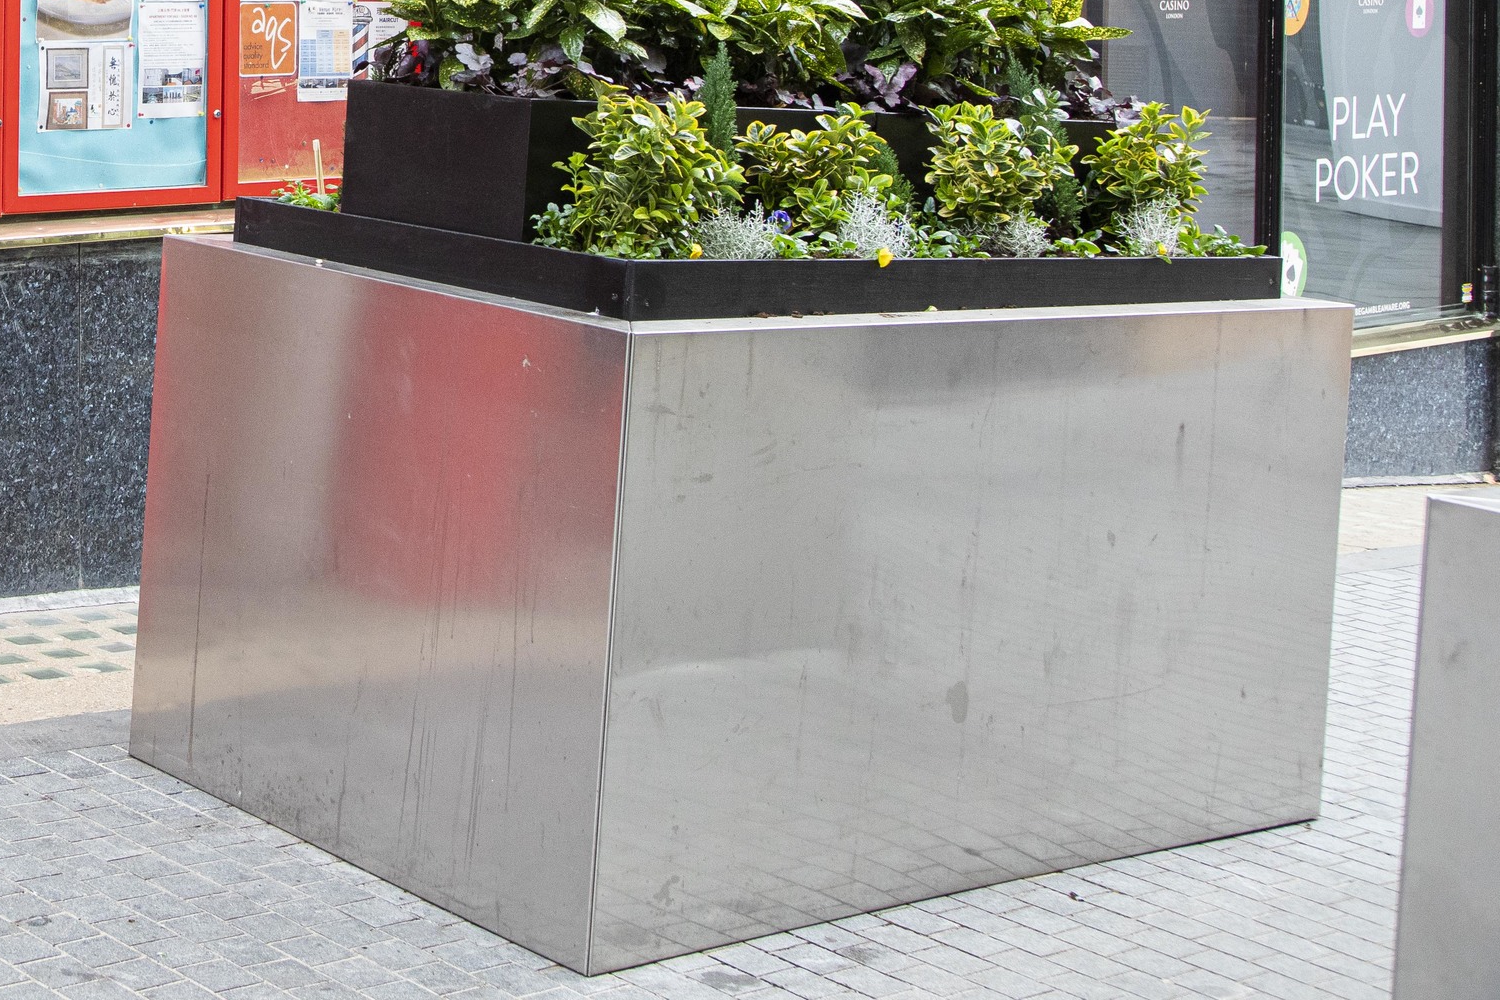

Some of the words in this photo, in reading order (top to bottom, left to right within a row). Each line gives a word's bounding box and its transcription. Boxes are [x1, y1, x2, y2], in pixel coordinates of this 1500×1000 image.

[1159, 0, 1189, 10] CASINO
[243, 52, 263, 60] quality
[243, 61, 269, 69] standard
[1332, 93, 1406, 141] PLAY
[1315, 151, 1419, 202] POKER
